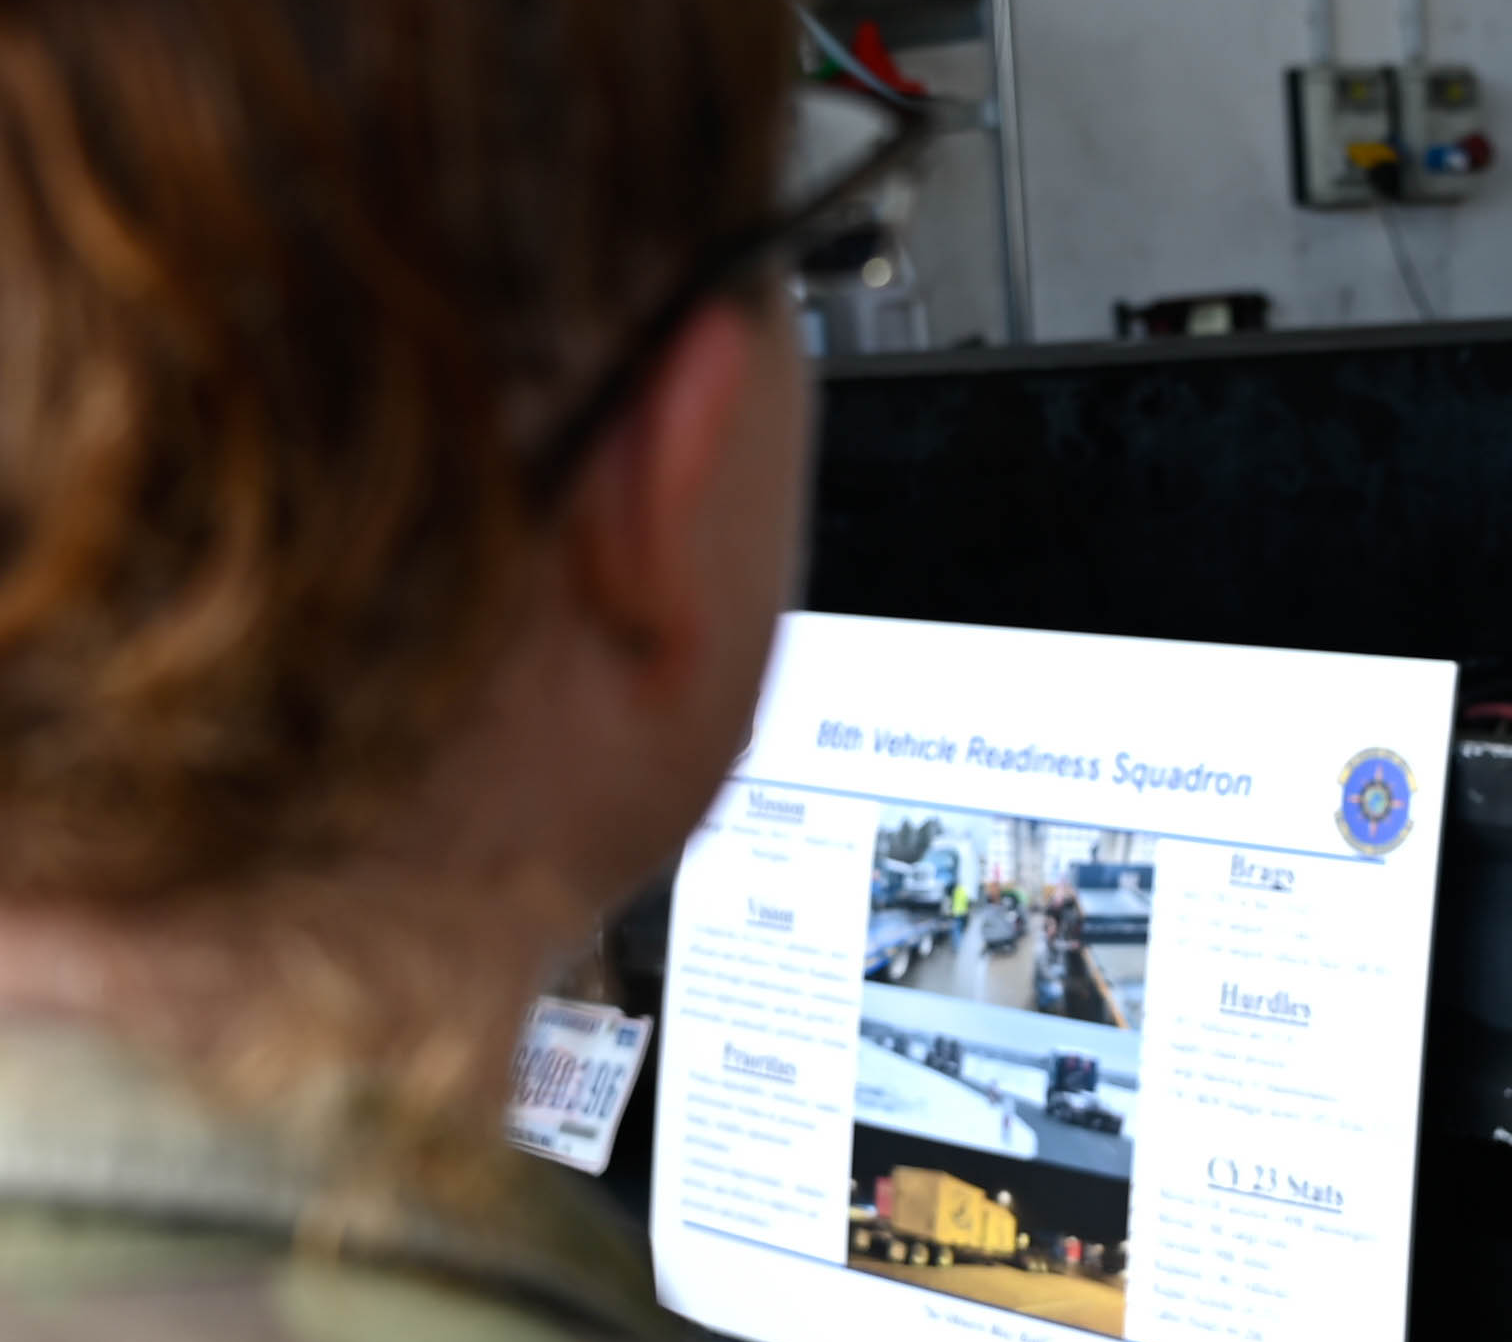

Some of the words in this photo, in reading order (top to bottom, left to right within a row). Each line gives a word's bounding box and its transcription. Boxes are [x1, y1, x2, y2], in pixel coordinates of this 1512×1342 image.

[817, 718, 864, 752] 86th
[873, 727, 958, 764] Vehicle
[966, 735, 1101, 781] Readiness
[1112, 752, 1253, 796] Squadron
[1253, 1164, 1279, 1193] 23
[1287, 1173, 1345, 1207] Stats
